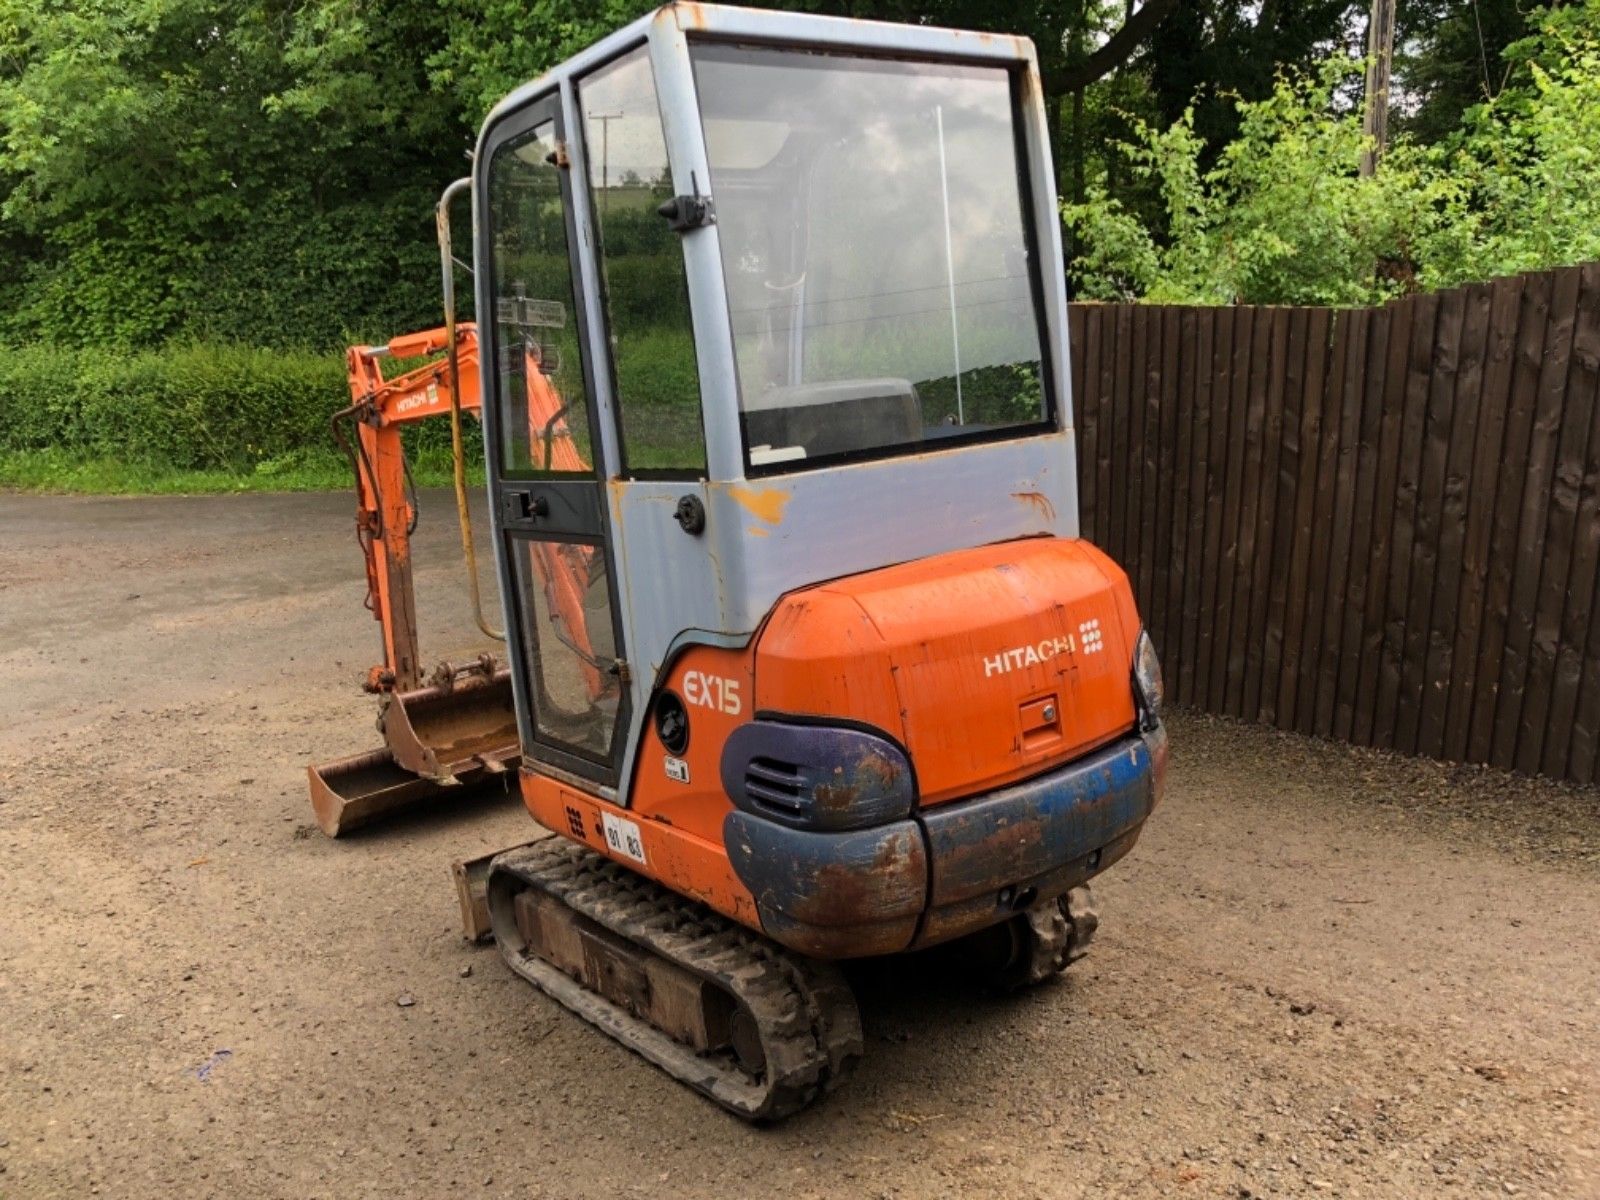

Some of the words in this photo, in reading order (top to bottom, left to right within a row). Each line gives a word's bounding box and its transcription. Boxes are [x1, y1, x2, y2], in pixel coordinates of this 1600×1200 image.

[396, 391, 427, 413] HITACHI
[982, 633, 1076, 678] HITACHI
[683, 670, 742, 715] EX15
